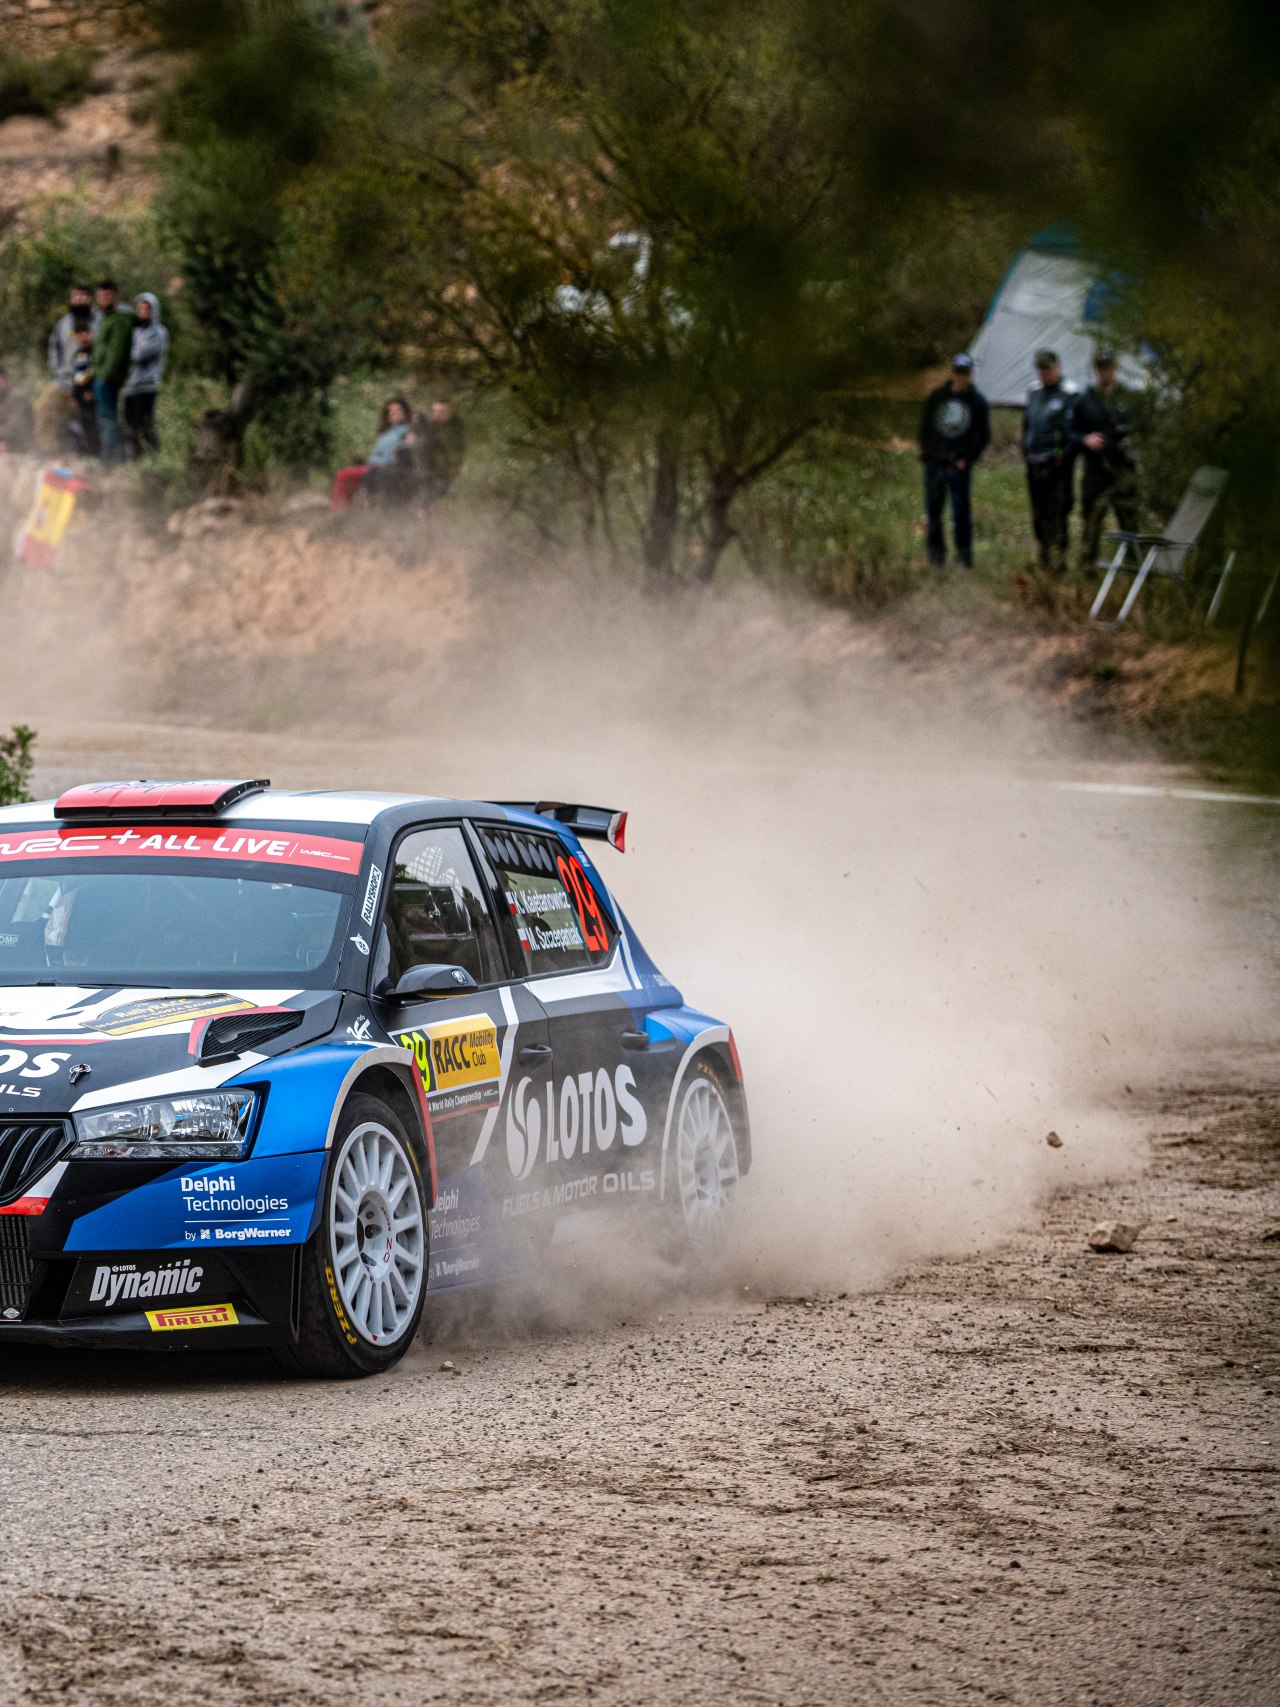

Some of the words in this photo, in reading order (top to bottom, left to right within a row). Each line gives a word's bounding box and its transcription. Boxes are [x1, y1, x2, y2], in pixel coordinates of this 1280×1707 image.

[138, 834, 201, 851] ALL
[213, 837, 290, 857] LIVE
[511, 891, 526, 914] K.
[556, 855, 609, 951] 29
[525, 927, 541, 951] M.
[535, 921, 584, 952] Szczepaniak
[470, 1028, 494, 1049] Mobility
[433, 1034, 471, 1075] RACC
[472, 1049, 487, 1067] Club
[454, 1090, 482, 1105] Championship
[546, 1064, 647, 1163] LOTOS
[180, 1176, 236, 1194] Delphi
[554, 1175, 598, 1203] MOTOR
[602, 1170, 656, 1193] OILS
[183, 1195, 289, 1214] Technologies
[184, 1230, 197, 1241] by
[215, 1227, 292, 1241] BorgWarner
[431, 1212, 480, 1239] Technologies
[89, 1259, 204, 1307] Dynamic
[154, 1307, 229, 1327] PIRELLI
